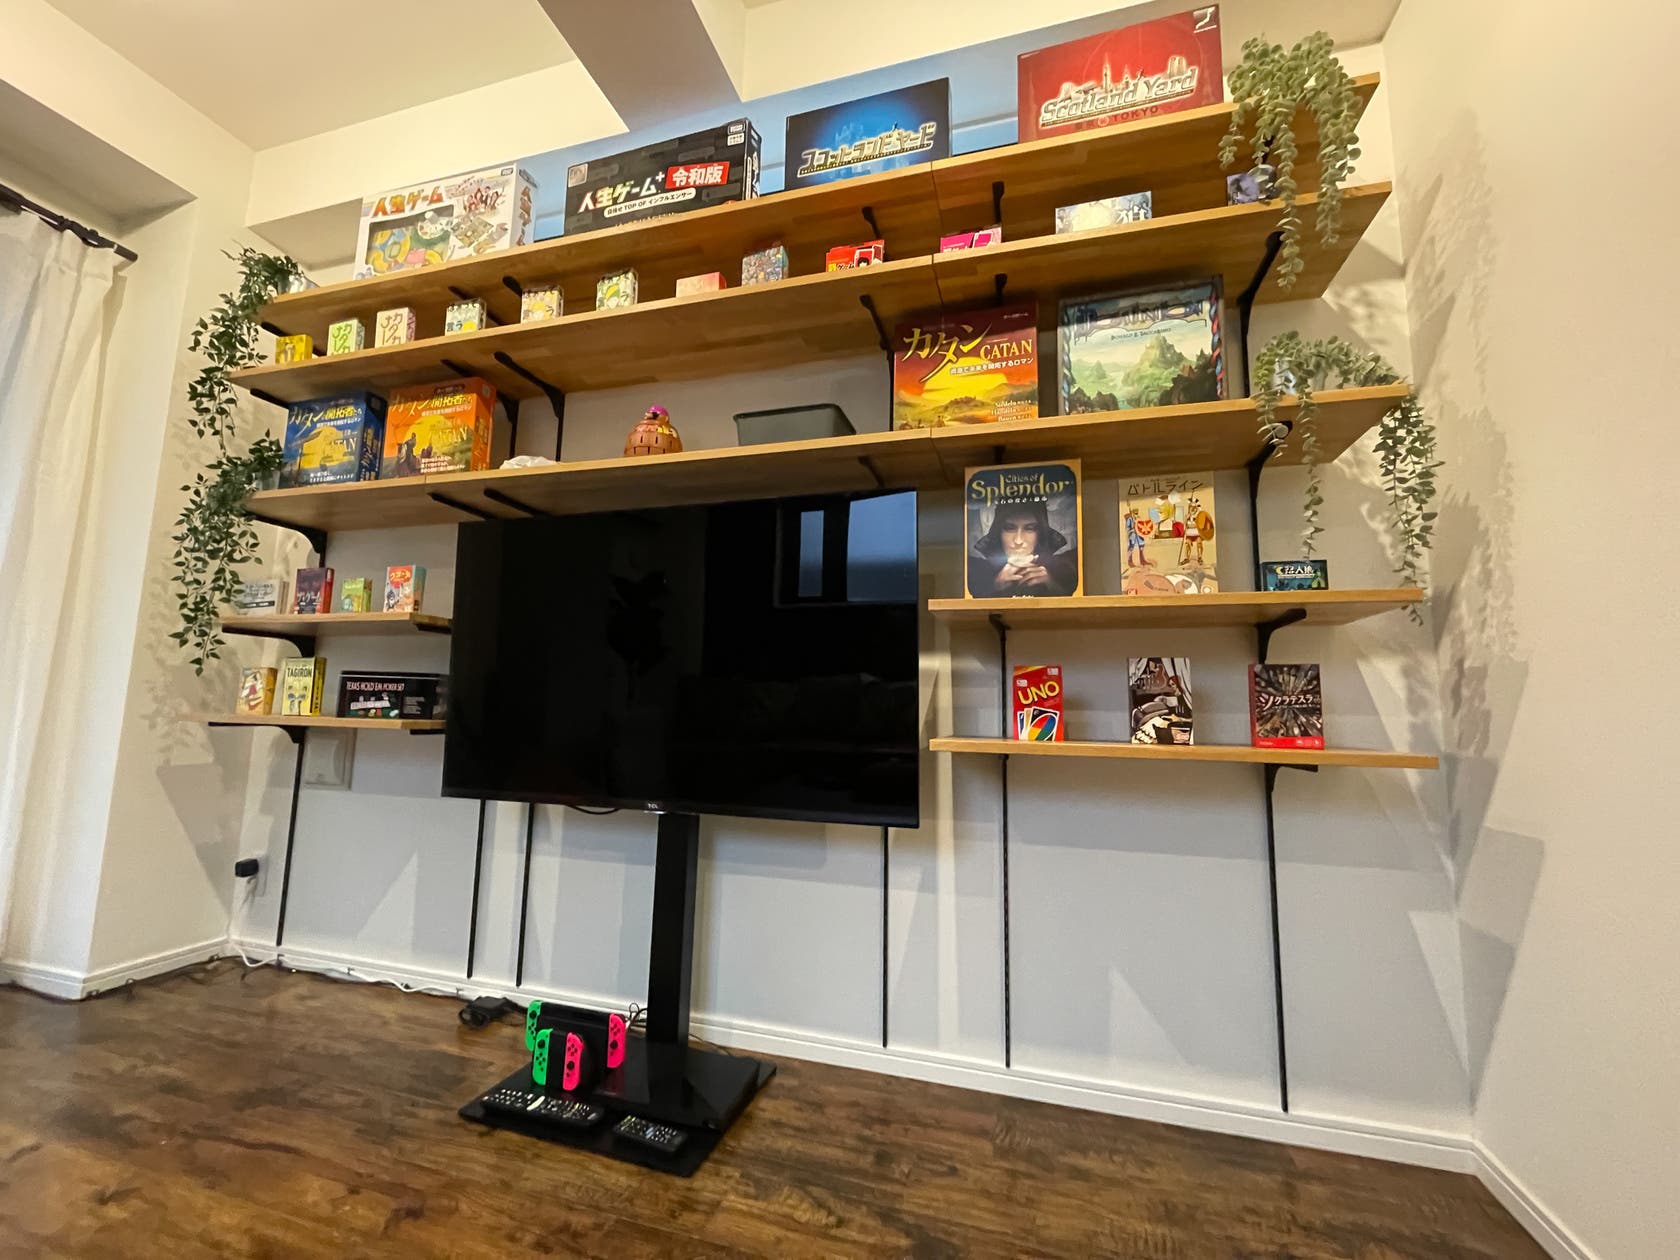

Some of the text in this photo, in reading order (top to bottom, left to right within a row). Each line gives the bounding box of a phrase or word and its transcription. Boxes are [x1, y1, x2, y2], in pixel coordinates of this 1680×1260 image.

[1042, 82, 1138, 122] Scotland
[1143, 67, 1198, 99] Yard
[1112, 105, 1159, 121] TOKYO
[801, 123, 936, 169] スコットランドヤード
[672, 164, 724, 187] 令和版
[373, 186, 443, 216] 人生ゲーム
[624, 203, 637, 211] TOP
[902, 323, 992, 383] カタン
[980, 338, 1033, 361] CATAN
[971, 473, 1070, 508] Splendor
[1127, 480, 1203, 496] バトルライン
[346, 681, 360, 690] TEXAS
[1018, 681, 1060, 705] UNO
[1259, 692, 1313, 710] ソクラテスラ
